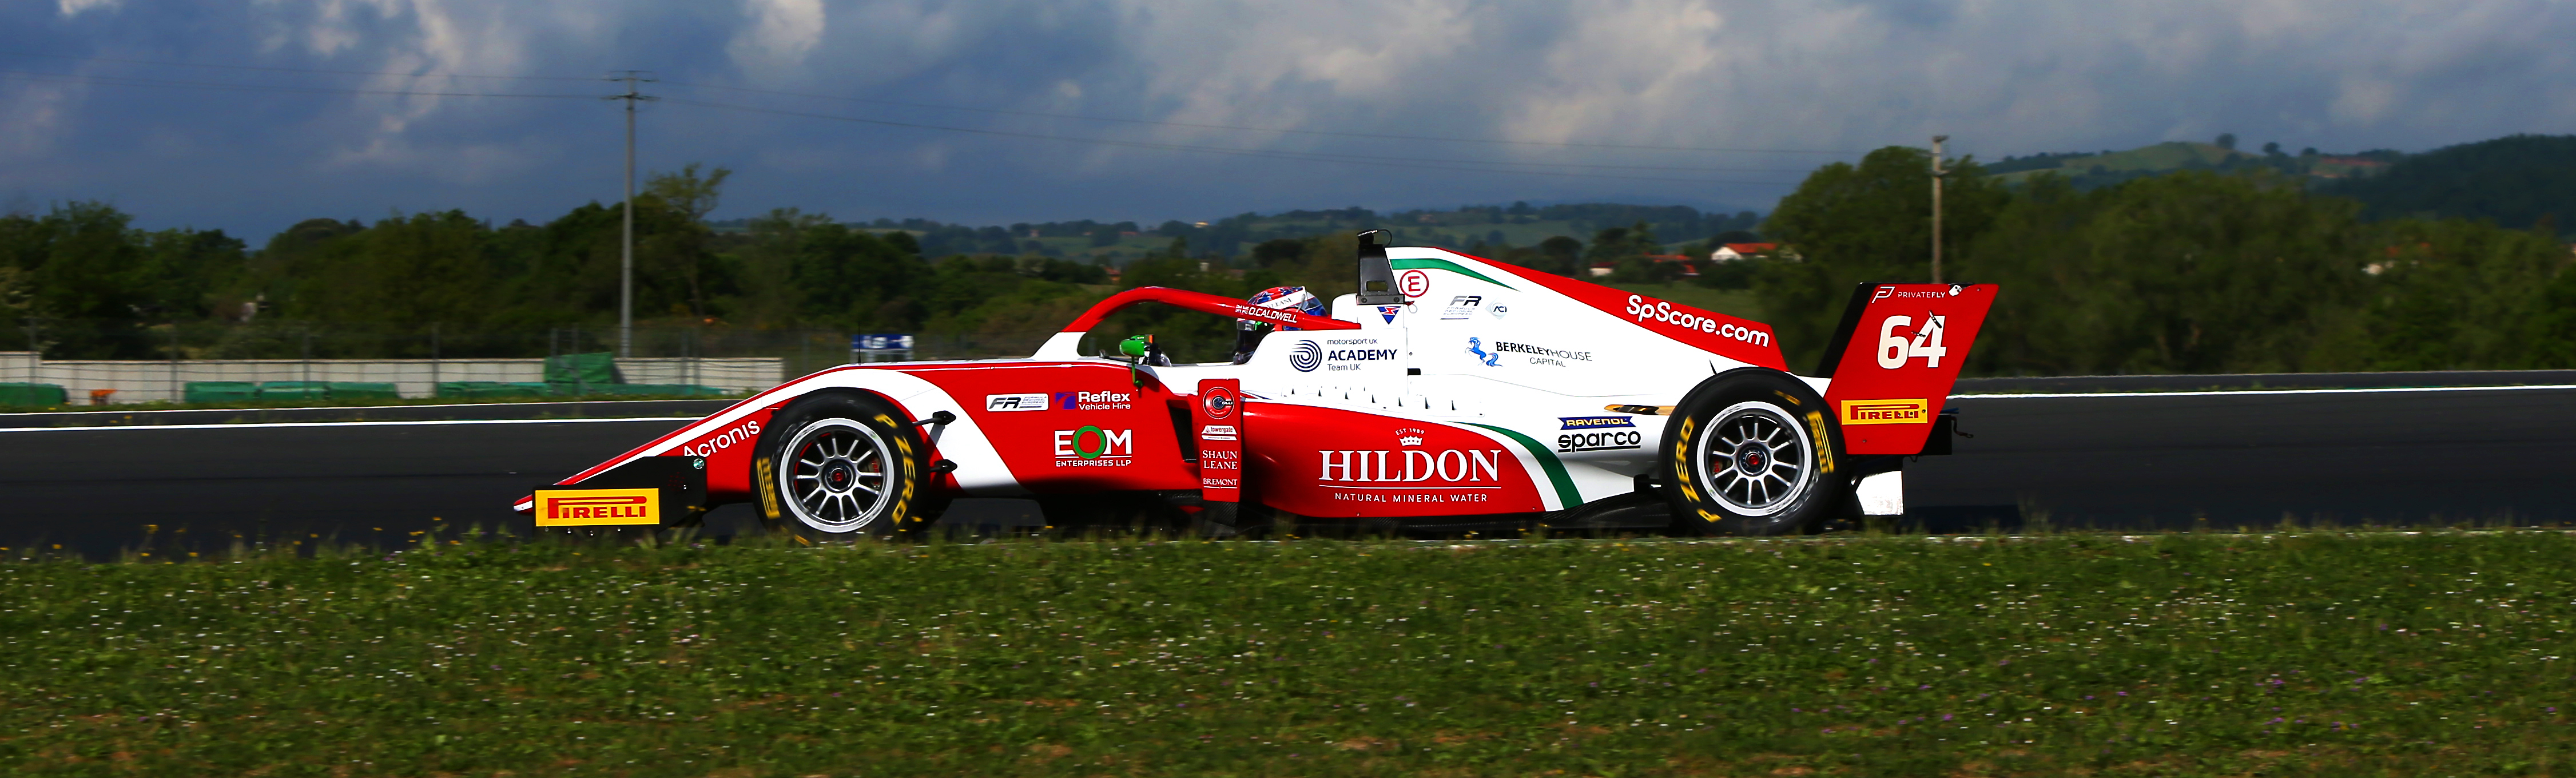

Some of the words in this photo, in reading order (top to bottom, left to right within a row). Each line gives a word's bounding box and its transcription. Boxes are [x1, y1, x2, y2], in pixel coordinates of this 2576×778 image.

[1449, 295, 1482, 306] FR
[1626, 295, 1769, 347] SpScore.com
[1878, 315, 1946, 369] 64
[1328, 349, 1398, 361] ACADEMY
[1496, 342, 1592, 362] BERKELEYHOUSE
[1529, 358, 1566, 367] CAPITAL
[989, 397, 1021, 409] FR
[1078, 391, 1130, 402] Reflex
[1850, 403, 1919, 420] PIRELLI
[1566, 418, 1629, 427] RAVENOL
[683, 420, 760, 458] Acronis
[1055, 425, 1132, 459] EOM
[1558, 431, 1641, 452] sparco
[1202, 450, 1237, 459] SHAUN
[1675, 415, 1700, 503] ZERO
[874, 414, 898, 428] P
[892, 435, 916, 525] ZERO
[1203, 461, 1237, 470] LEANE
[1319, 449, 1501, 482] HILDON
[1335, 493, 1386, 502] NATURAL
[1393, 494, 1445, 503] MINERAL
[1450, 493, 1488, 502] WATER
[547, 496, 647, 518] PIRELLI
[1697, 509, 1722, 523] P
